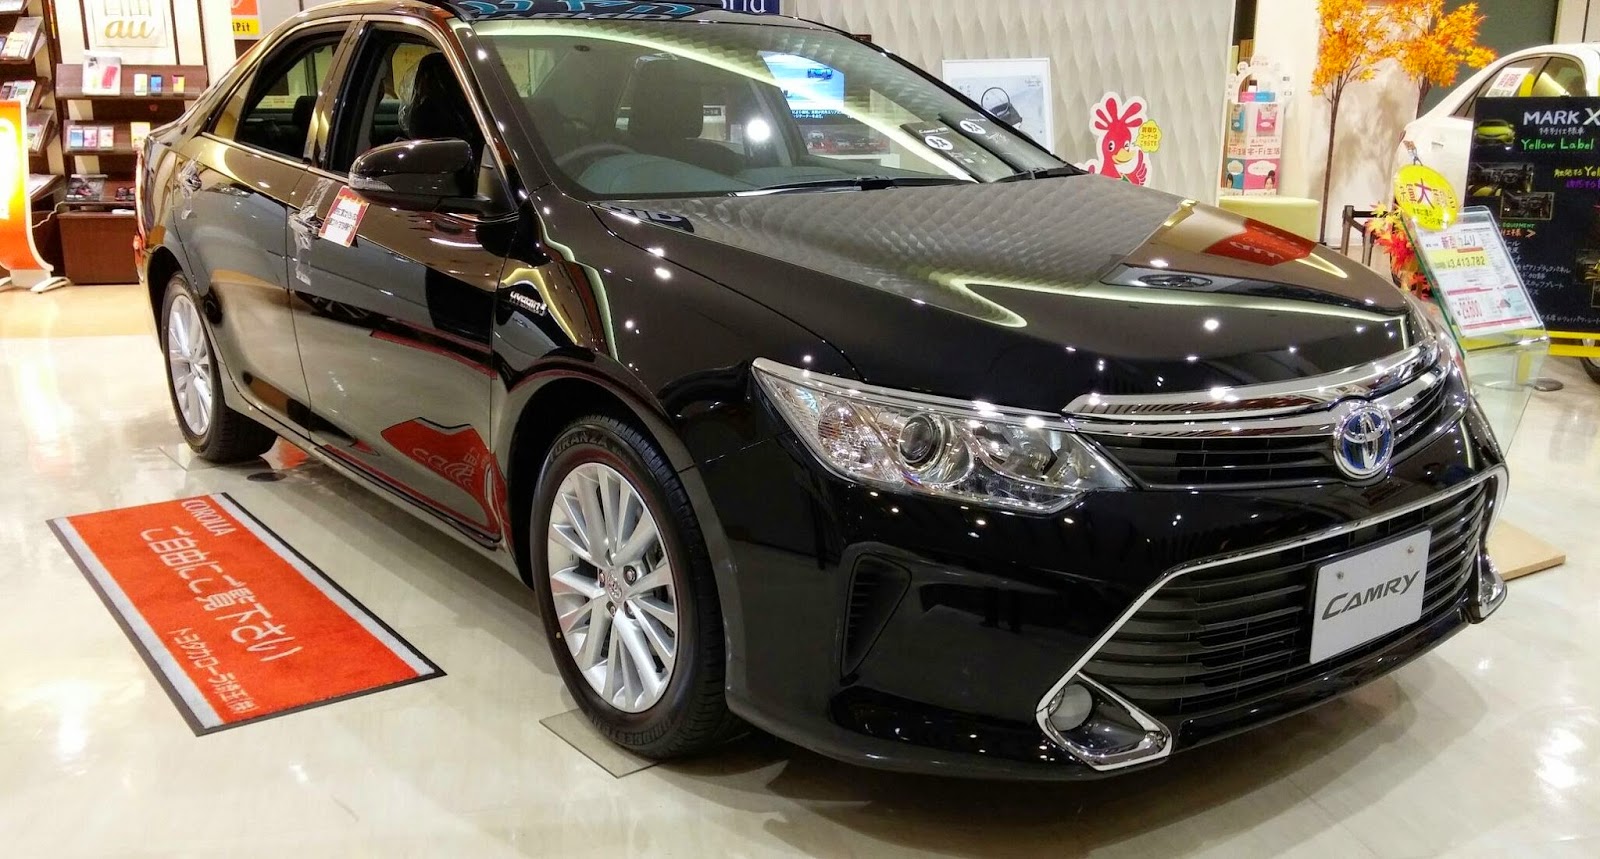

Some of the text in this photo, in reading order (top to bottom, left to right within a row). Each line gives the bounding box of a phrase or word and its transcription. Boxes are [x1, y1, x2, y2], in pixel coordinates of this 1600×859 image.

[104, 19, 156, 39] au
[1522, 107, 1600, 127] MARK X
[1520, 137, 1595, 151] Yellow Label
[181, 498, 238, 538] COROLLA
[140, 525, 304, 662] ご自由にご覧下さい
[1321, 570, 1421, 621] CAMRY
